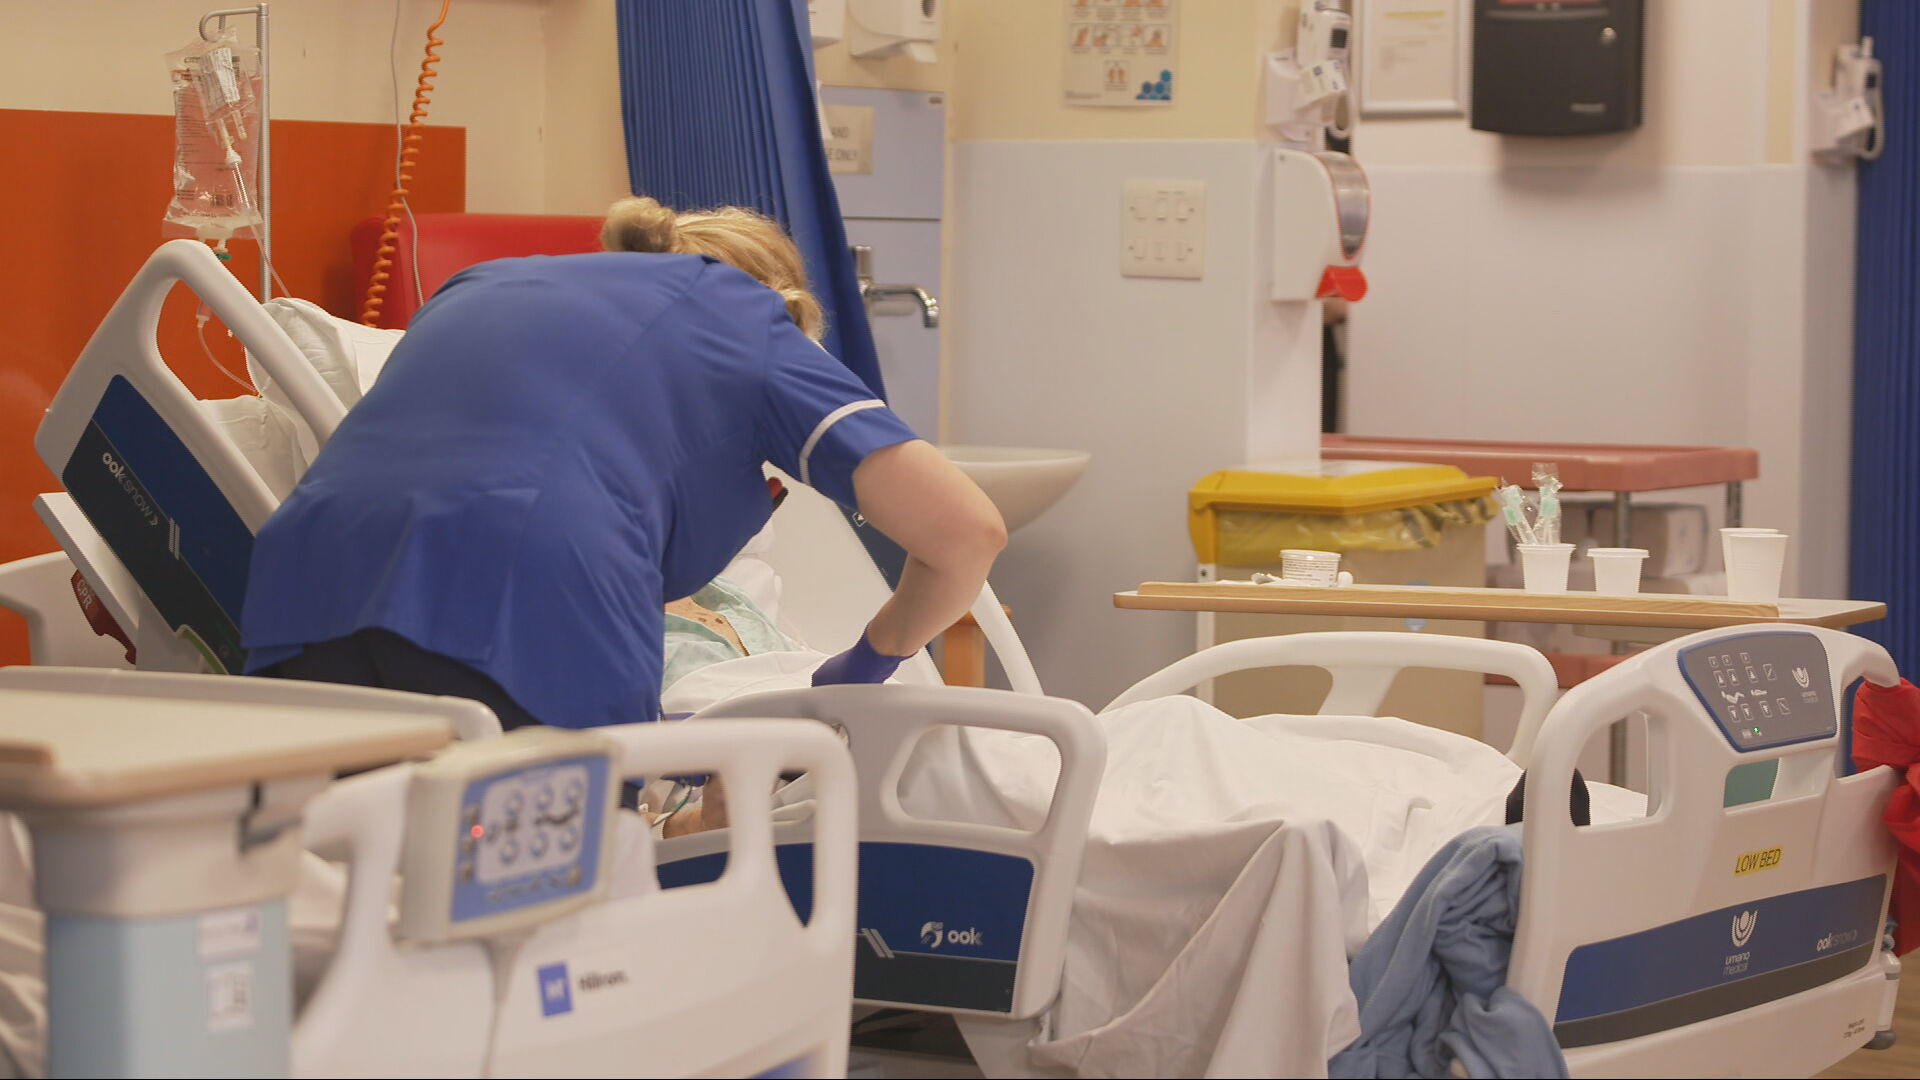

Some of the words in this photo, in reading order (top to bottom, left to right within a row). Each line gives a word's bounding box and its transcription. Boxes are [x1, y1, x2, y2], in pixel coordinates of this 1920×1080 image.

[77, 579, 93, 610] CPR
[1735, 852, 1760, 873] LOW
[1759, 848, 1781, 868] BED
[1725, 951, 1751, 966] umano
